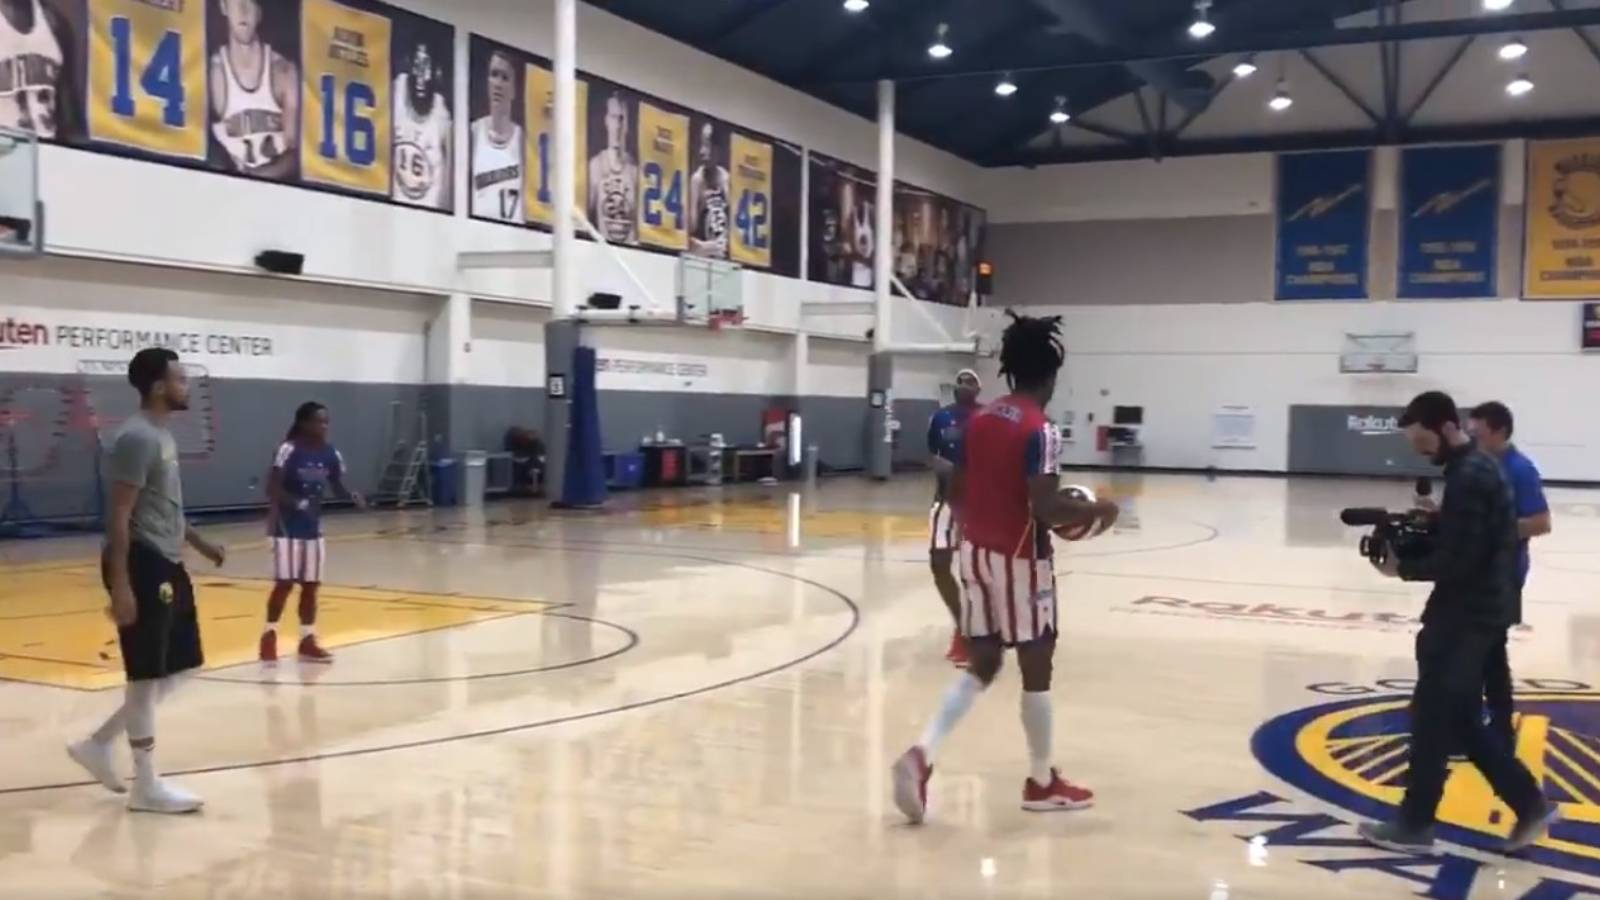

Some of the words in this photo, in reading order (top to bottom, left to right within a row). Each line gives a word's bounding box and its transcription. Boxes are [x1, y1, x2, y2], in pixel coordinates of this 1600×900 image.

[111, 16, 185, 127] 14
[319, 73, 376, 166] 16
[499, 187, 520, 220] 17
[643, 162, 684, 231] 24
[735, 188, 768, 248] 42
[56, 325, 201, 353] PERFORMANCE
[206, 334, 273, 356] CENTER
[1347, 415, 1399, 431] Rakut
